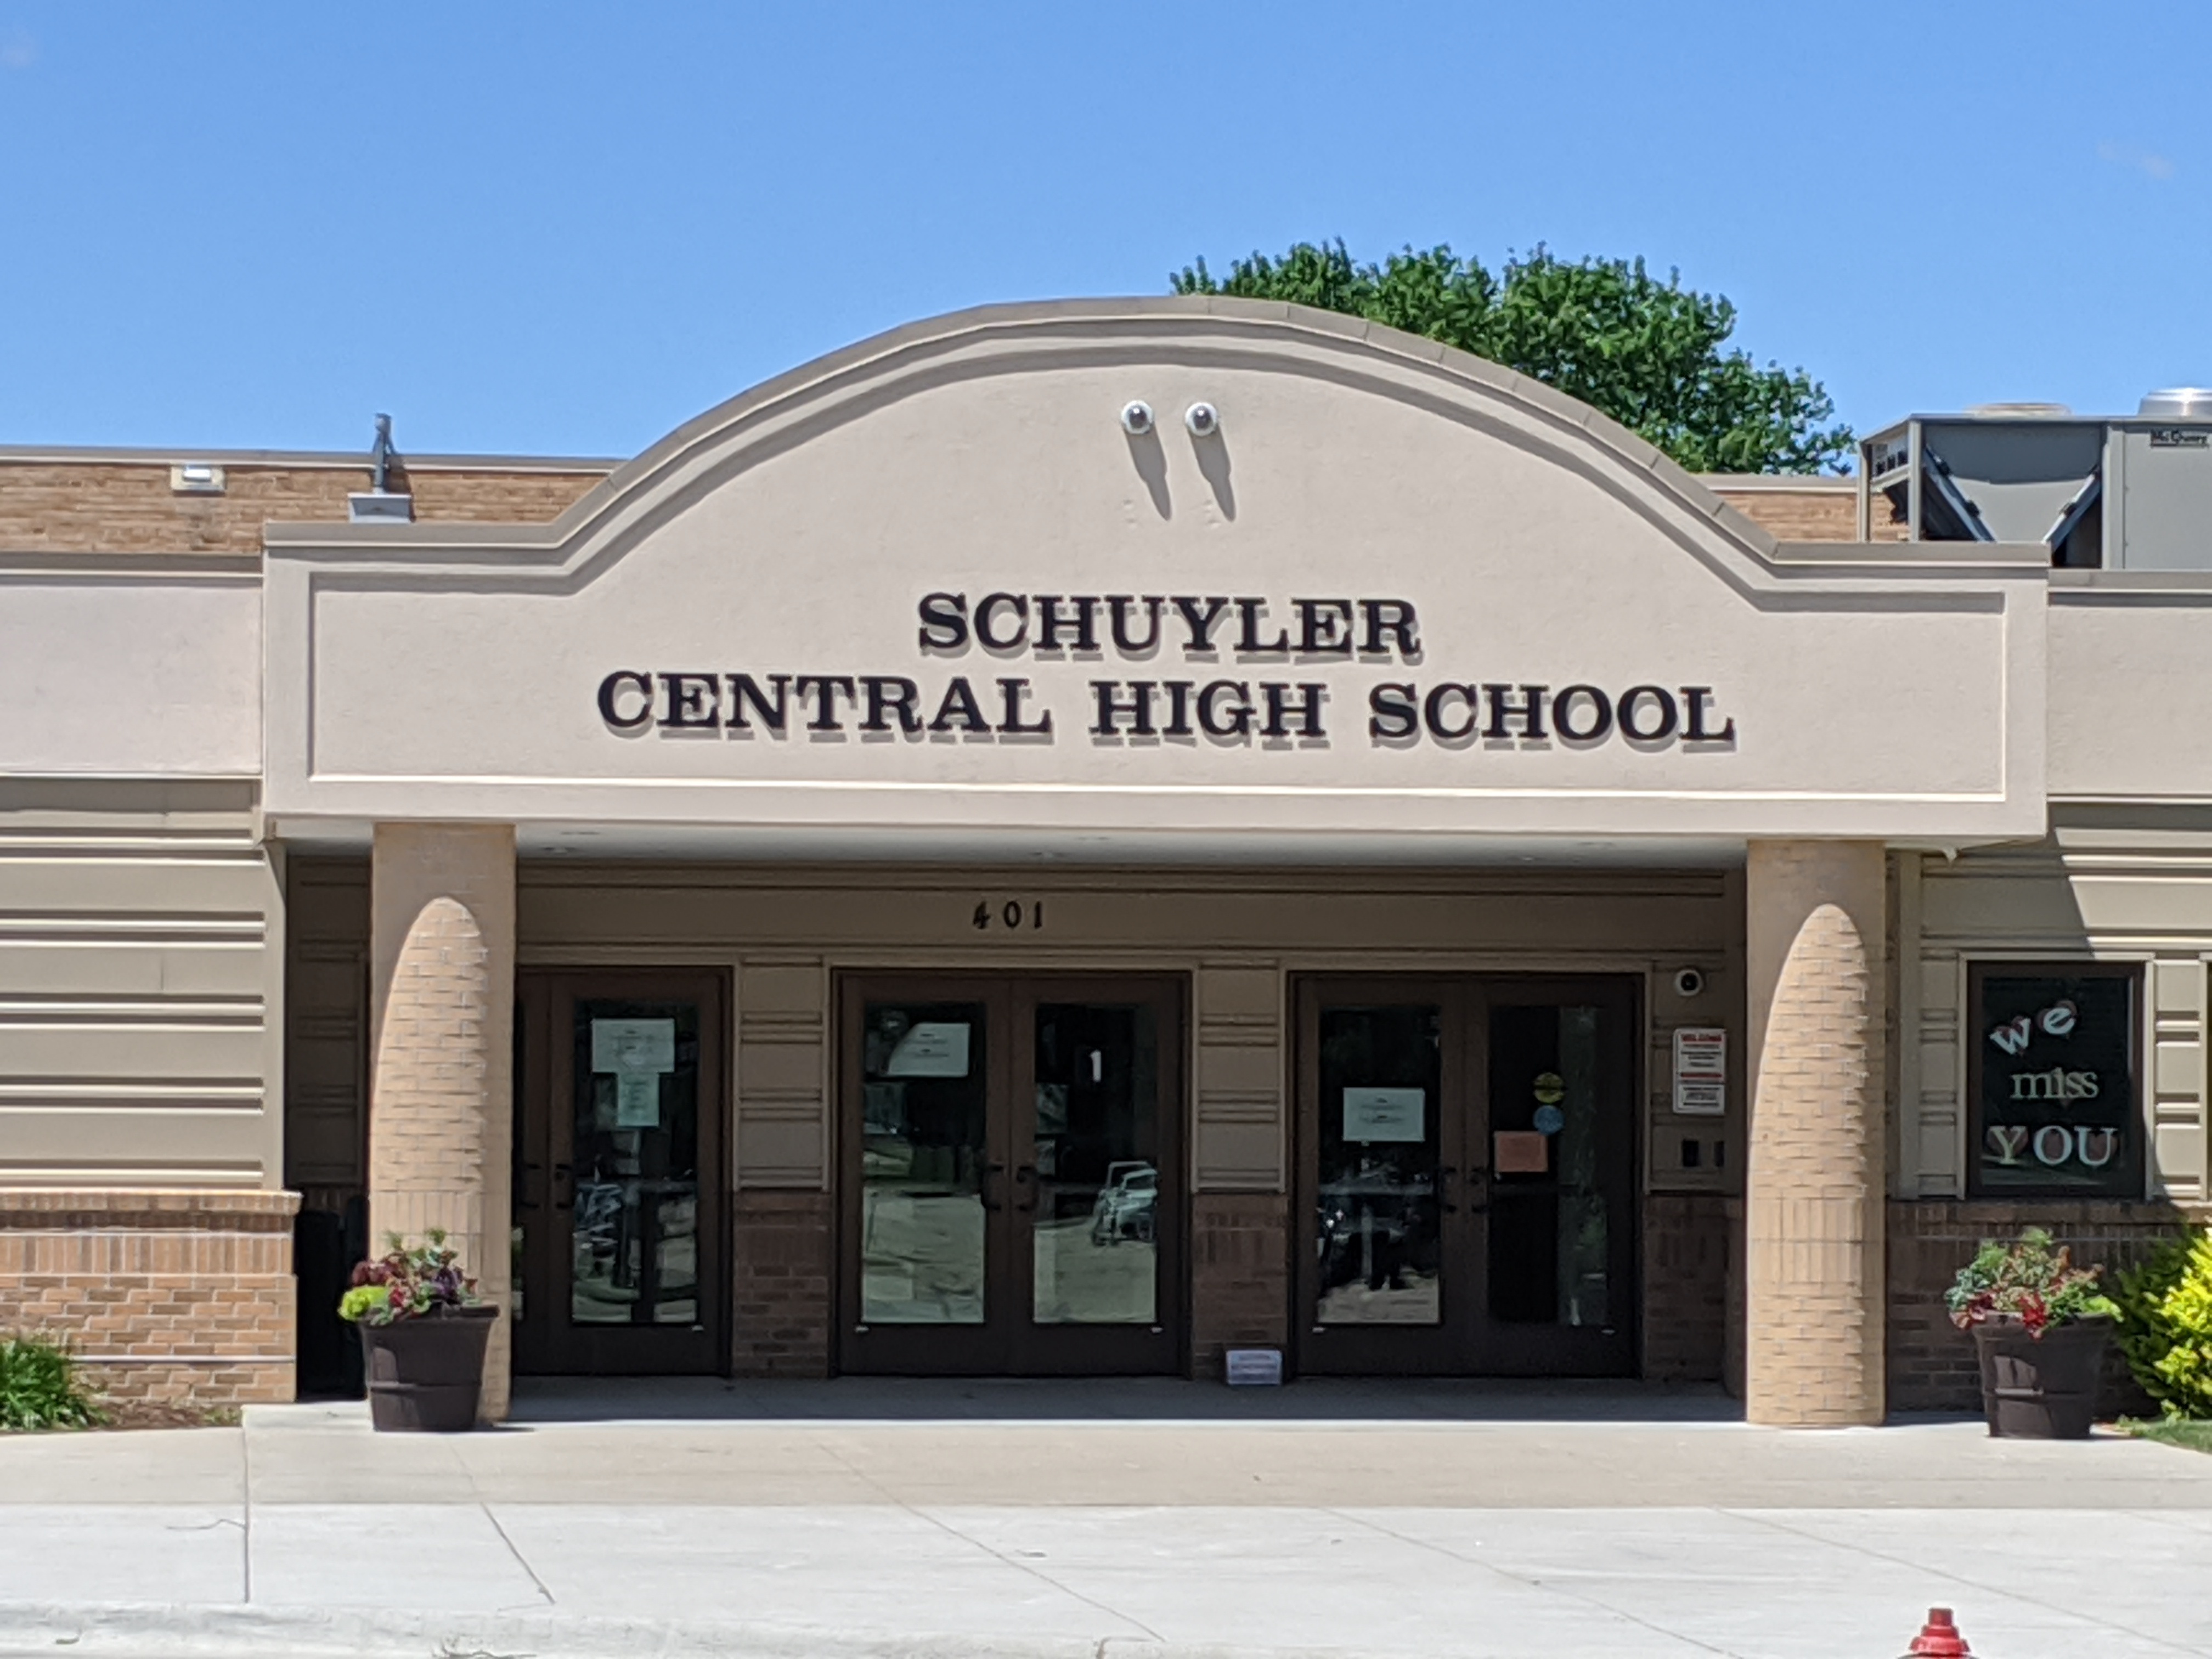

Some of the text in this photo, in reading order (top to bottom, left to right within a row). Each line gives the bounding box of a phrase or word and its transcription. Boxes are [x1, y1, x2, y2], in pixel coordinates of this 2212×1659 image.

[918, 592, 1421, 656] SCHUYLER
[597, 670, 1735, 742] CENTRAL HIGH SCHOOL
[973, 901, 1042, 929] 401
[1089, 1049, 1102, 1082] 1
[2010, 1067, 2100, 1099] miss
[1989, 1125, 2118, 1166] YOU
